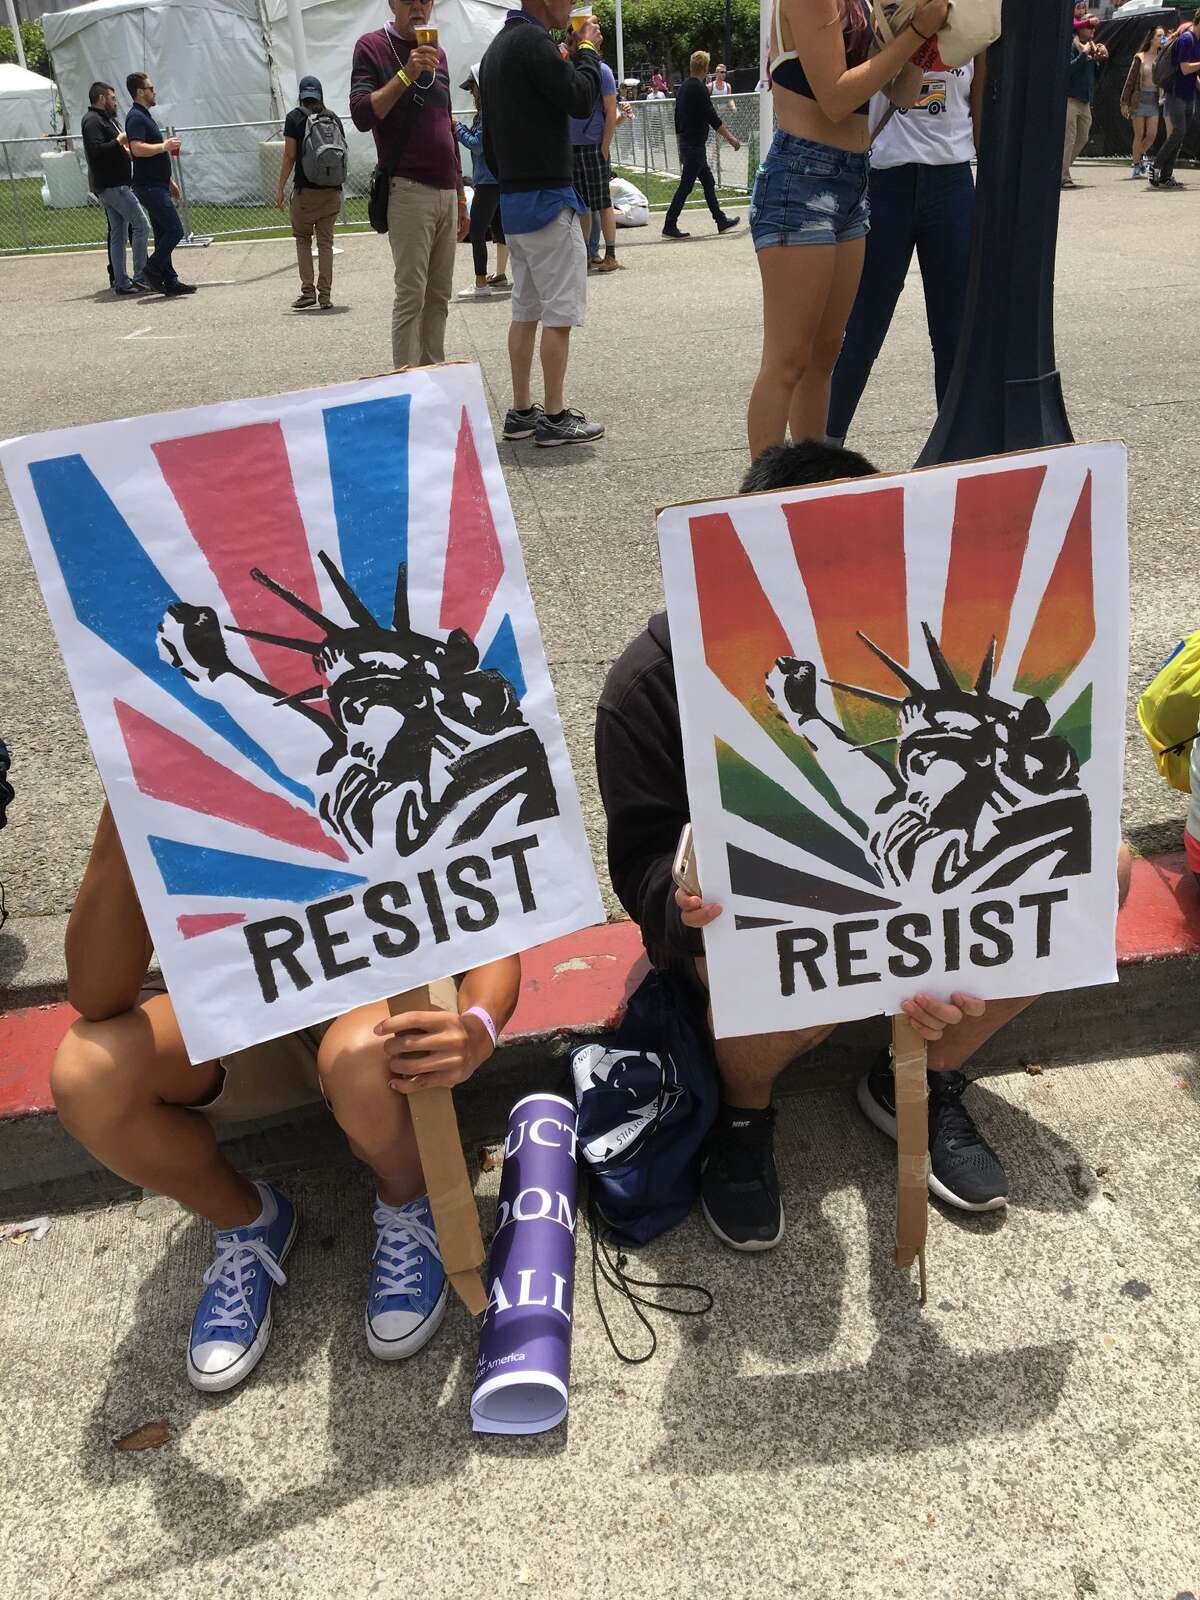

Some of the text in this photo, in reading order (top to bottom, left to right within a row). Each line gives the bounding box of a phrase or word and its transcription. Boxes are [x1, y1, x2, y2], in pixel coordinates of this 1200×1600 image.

[243, 834, 540, 1003] RESIST
[776, 888, 1069, 996] RESIST
[504, 1117, 577, 1162] UCT
[616, 1120, 644, 1146] DEVILS
[731, 1120, 751, 1128] NIKE
[487, 1352, 526, 1371] America
